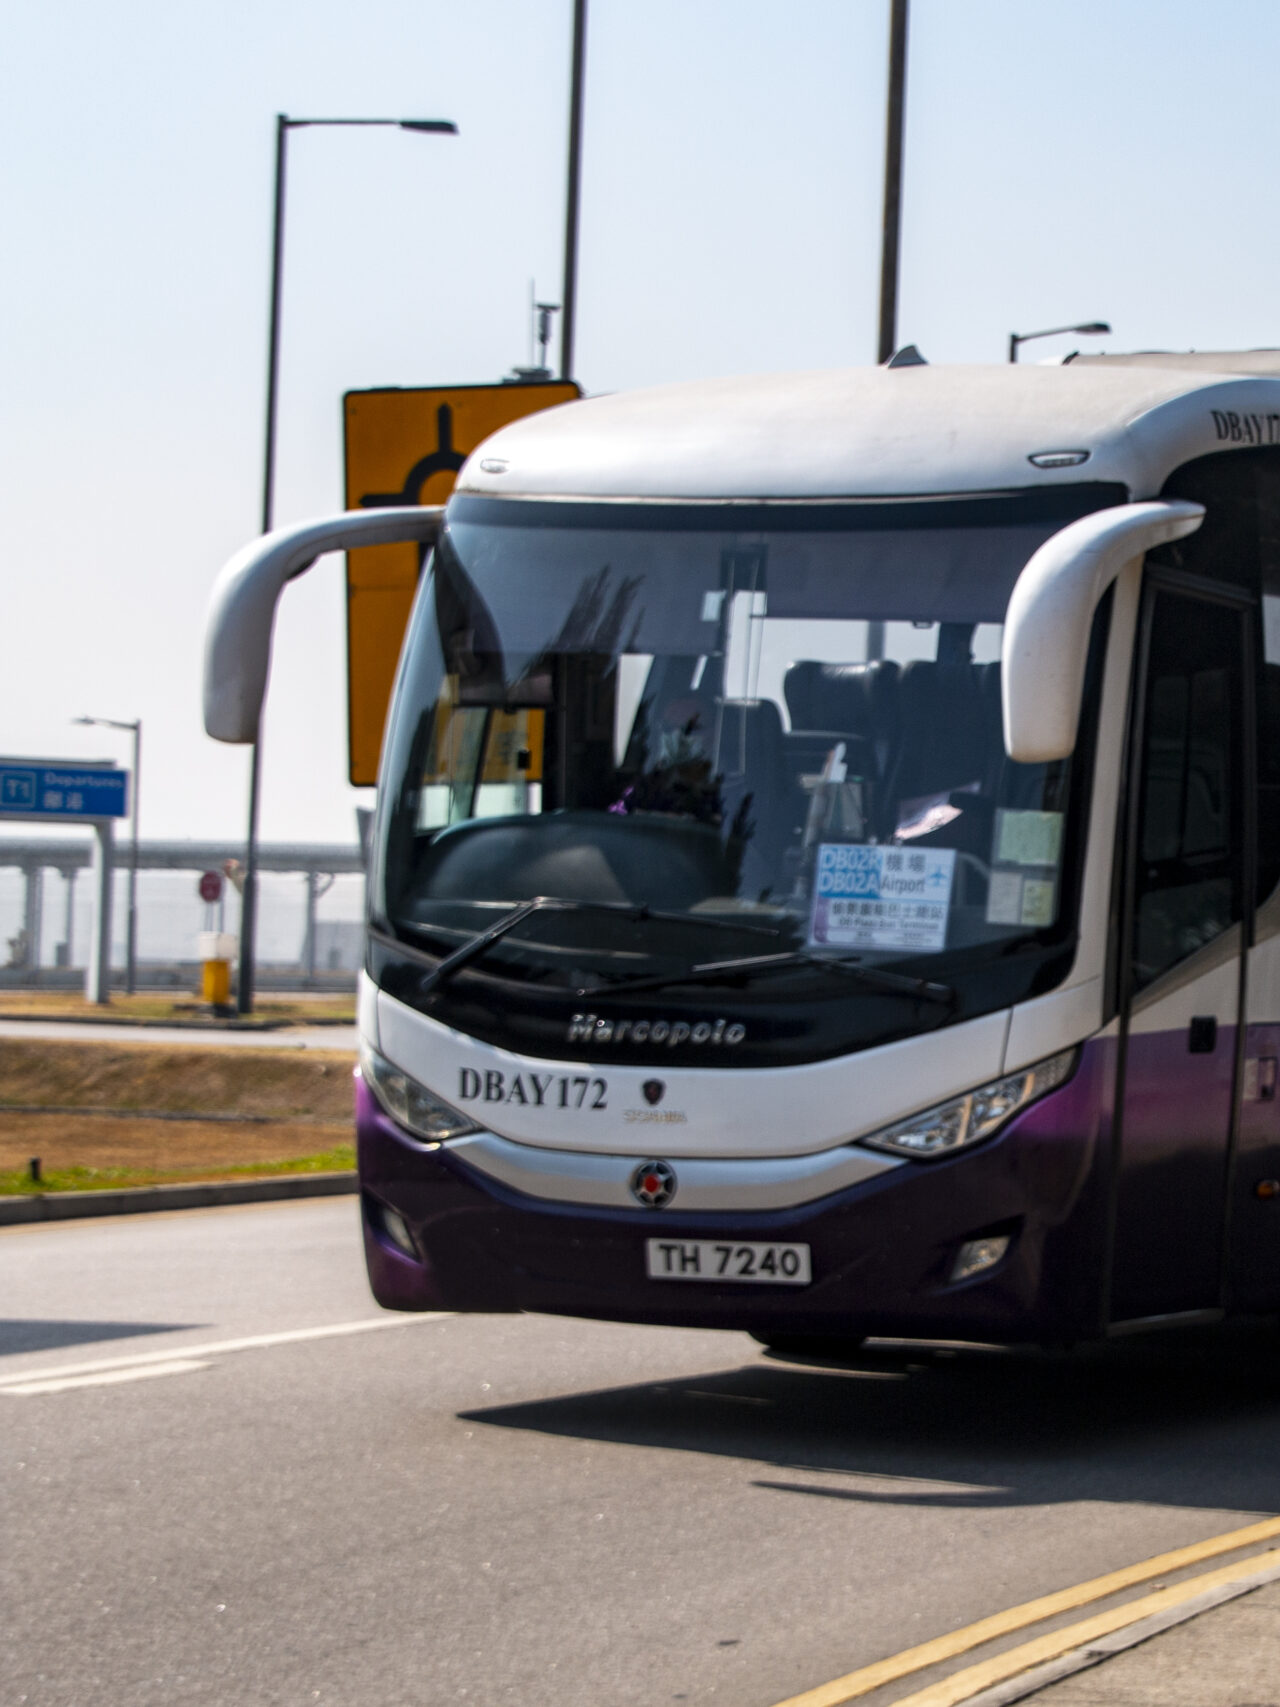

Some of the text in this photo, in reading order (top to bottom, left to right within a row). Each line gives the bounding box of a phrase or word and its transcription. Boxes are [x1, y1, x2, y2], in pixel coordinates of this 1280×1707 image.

[7, 779, 30, 798] T1
[44, 772, 123, 788] Departures
[821, 848, 882, 871] DB02R
[886, 853, 926, 873] 機場
[819, 871, 881, 893] DB02A
[881, 876, 925, 894] Airport
[567, 1013, 746, 1046] Marcopolo
[459, 1067, 609, 1110] DBAY172
[659, 1243, 801, 1277] TH 7240
